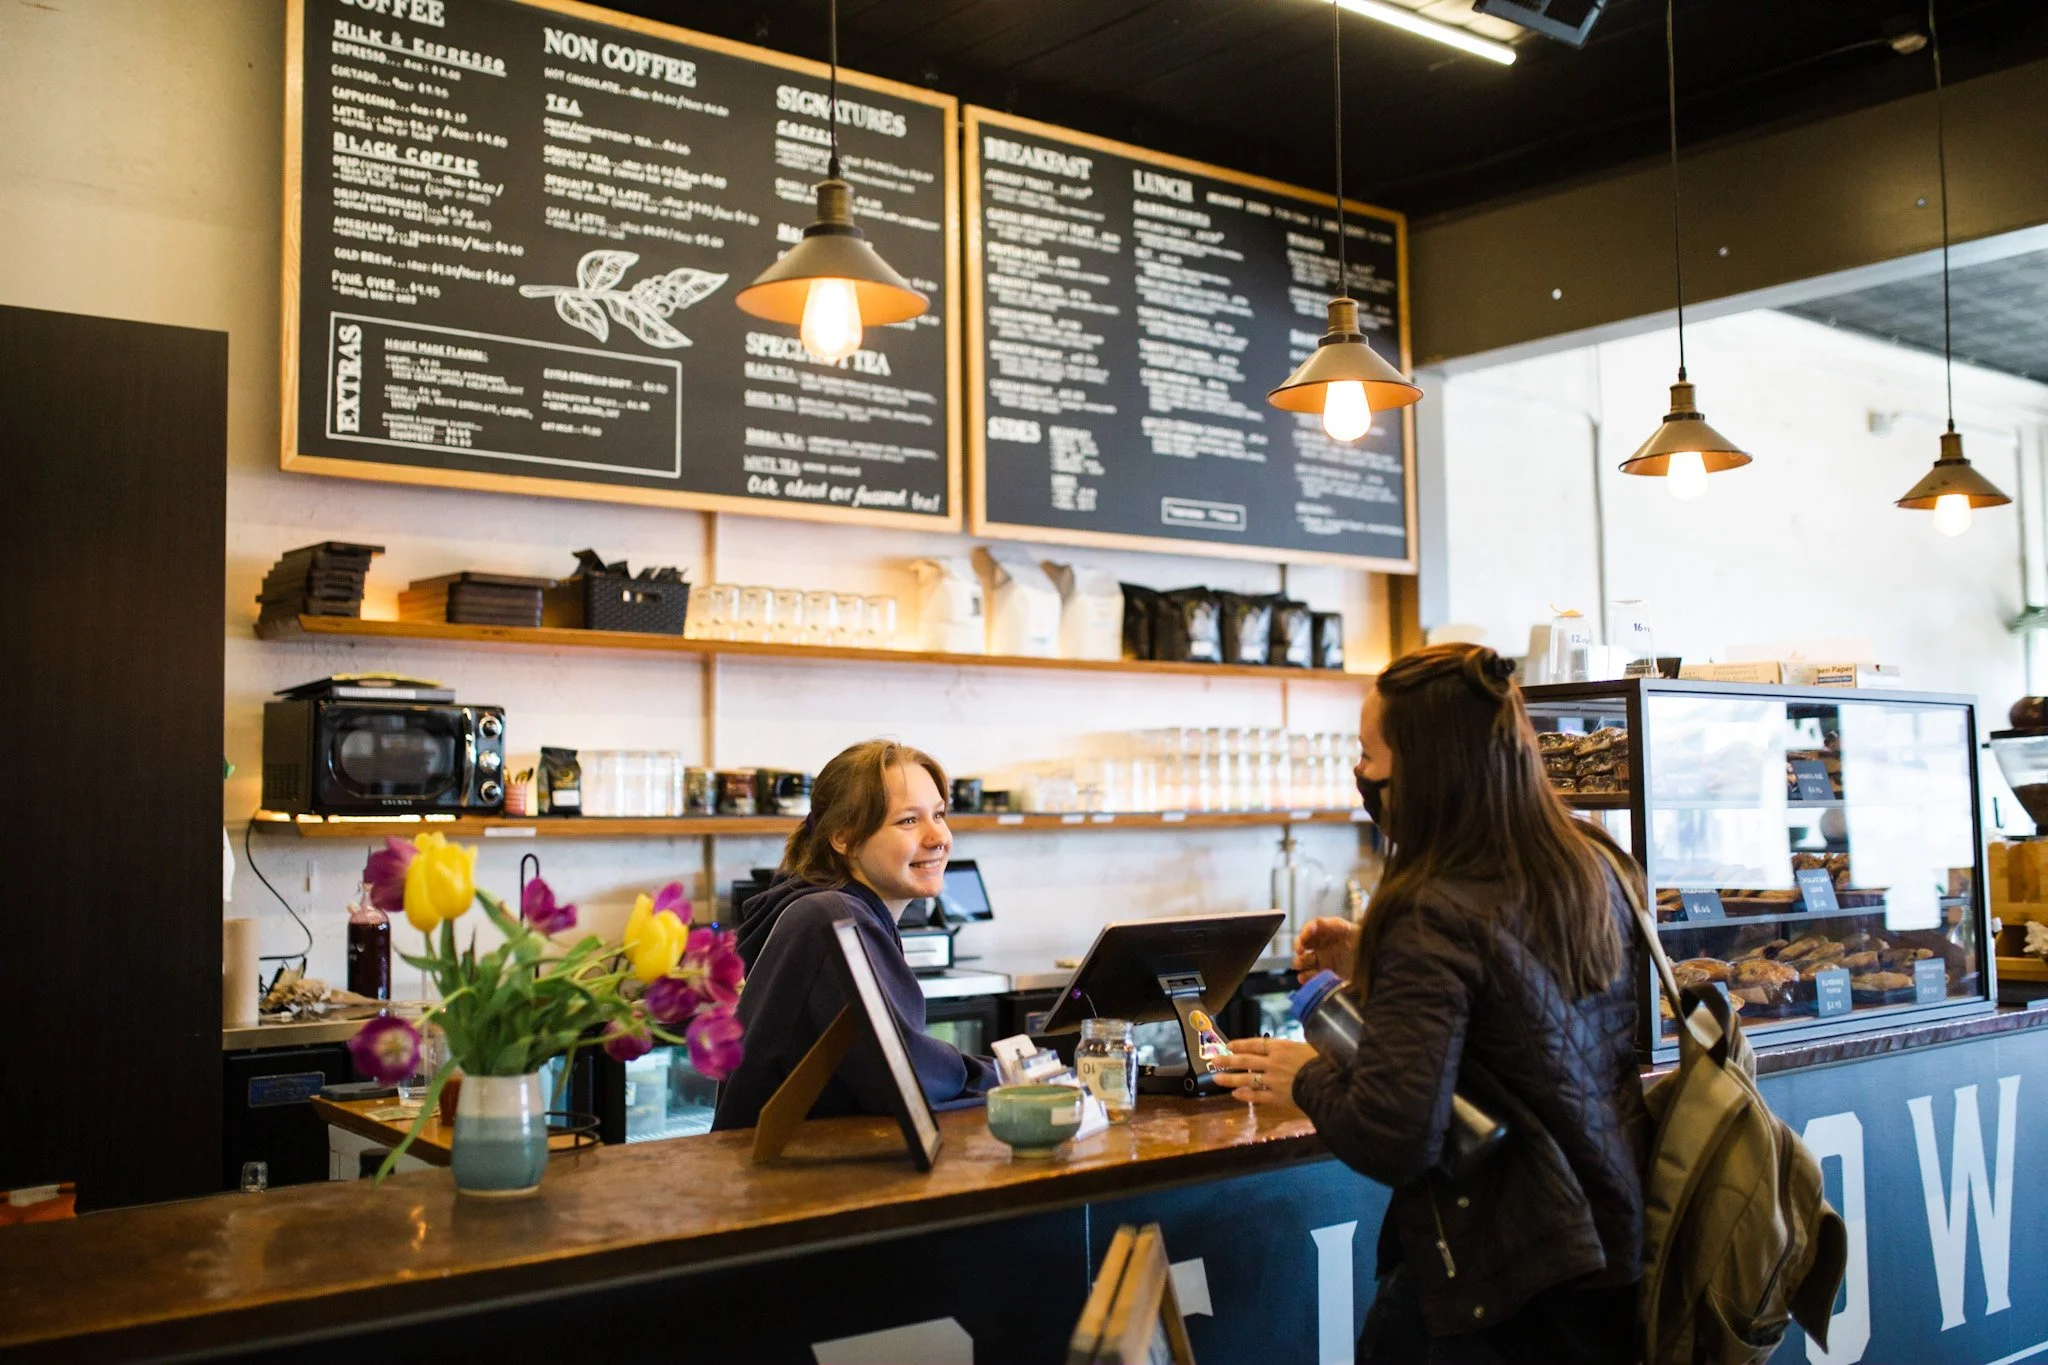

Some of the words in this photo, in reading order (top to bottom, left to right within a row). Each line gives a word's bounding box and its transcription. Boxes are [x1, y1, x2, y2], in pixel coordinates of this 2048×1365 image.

[333, 19, 384, 46] MILK
[391, 31, 404, 48] &
[412, 37, 506, 73] ESPRESSO
[543, 27, 598, 64] NON
[602, 43, 696, 88] COFFEE
[545, 93, 583, 115] TEA
[776, 85, 907, 137] SIGNATURES
[333, 131, 398, 158] BLACK
[405, 147, 479, 174] COFFEE
[984, 136, 1093, 180] BREAKFAST
[1132, 169, 1194, 203] LUNCH
[745, 332, 853, 370] SPECI
[854, 349, 891, 377] TEA
[337, 324, 362, 433] EXTRAS
[1832, 665, 1853, 675] Paper
